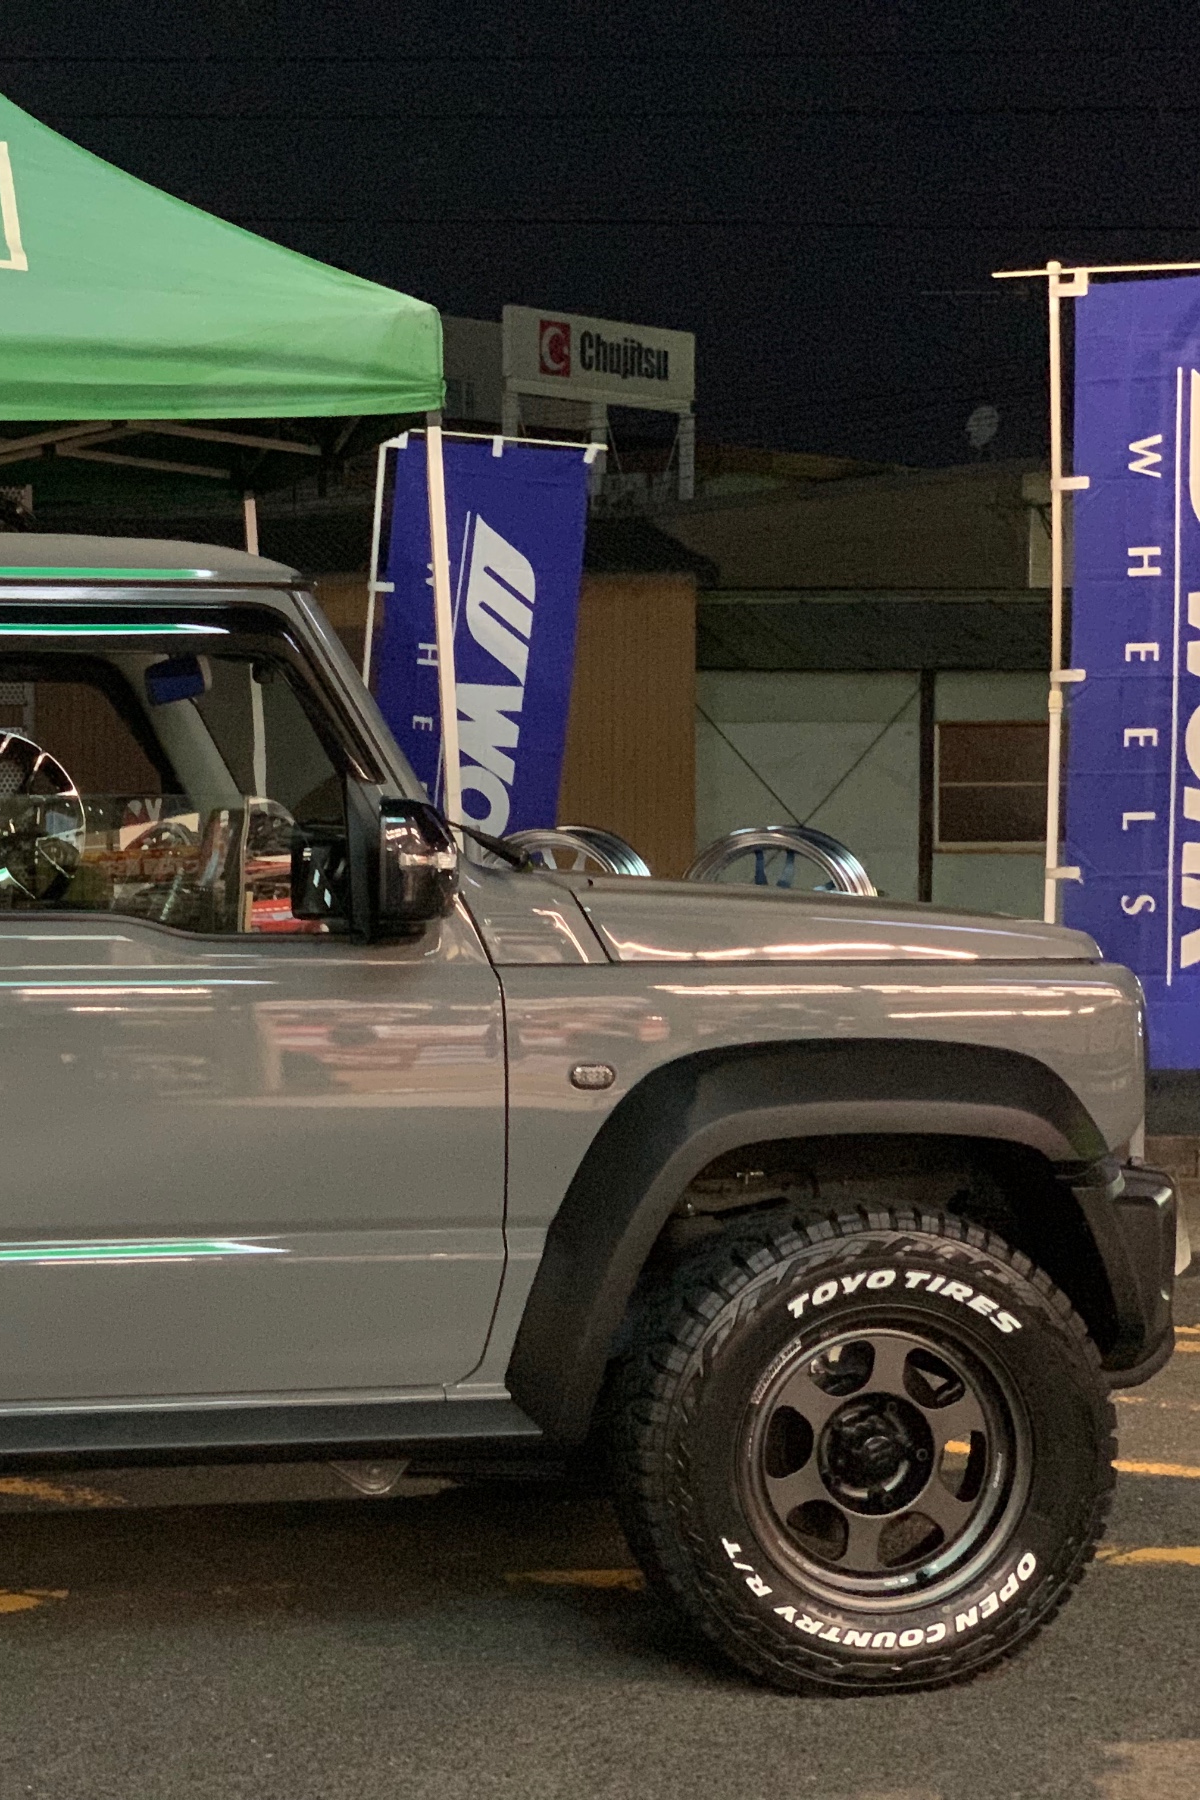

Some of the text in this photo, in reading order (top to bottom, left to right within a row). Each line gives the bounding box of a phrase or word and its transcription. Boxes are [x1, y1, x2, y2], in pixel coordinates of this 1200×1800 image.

[579, 330, 669, 380] Chujitsu
[1119, 433, 1164, 917] WHEELS
[787, 1269, 1023, 1334] TOYO TIRES
[721, 1537, 1038, 1650] OPEN COUNTRY R/T
